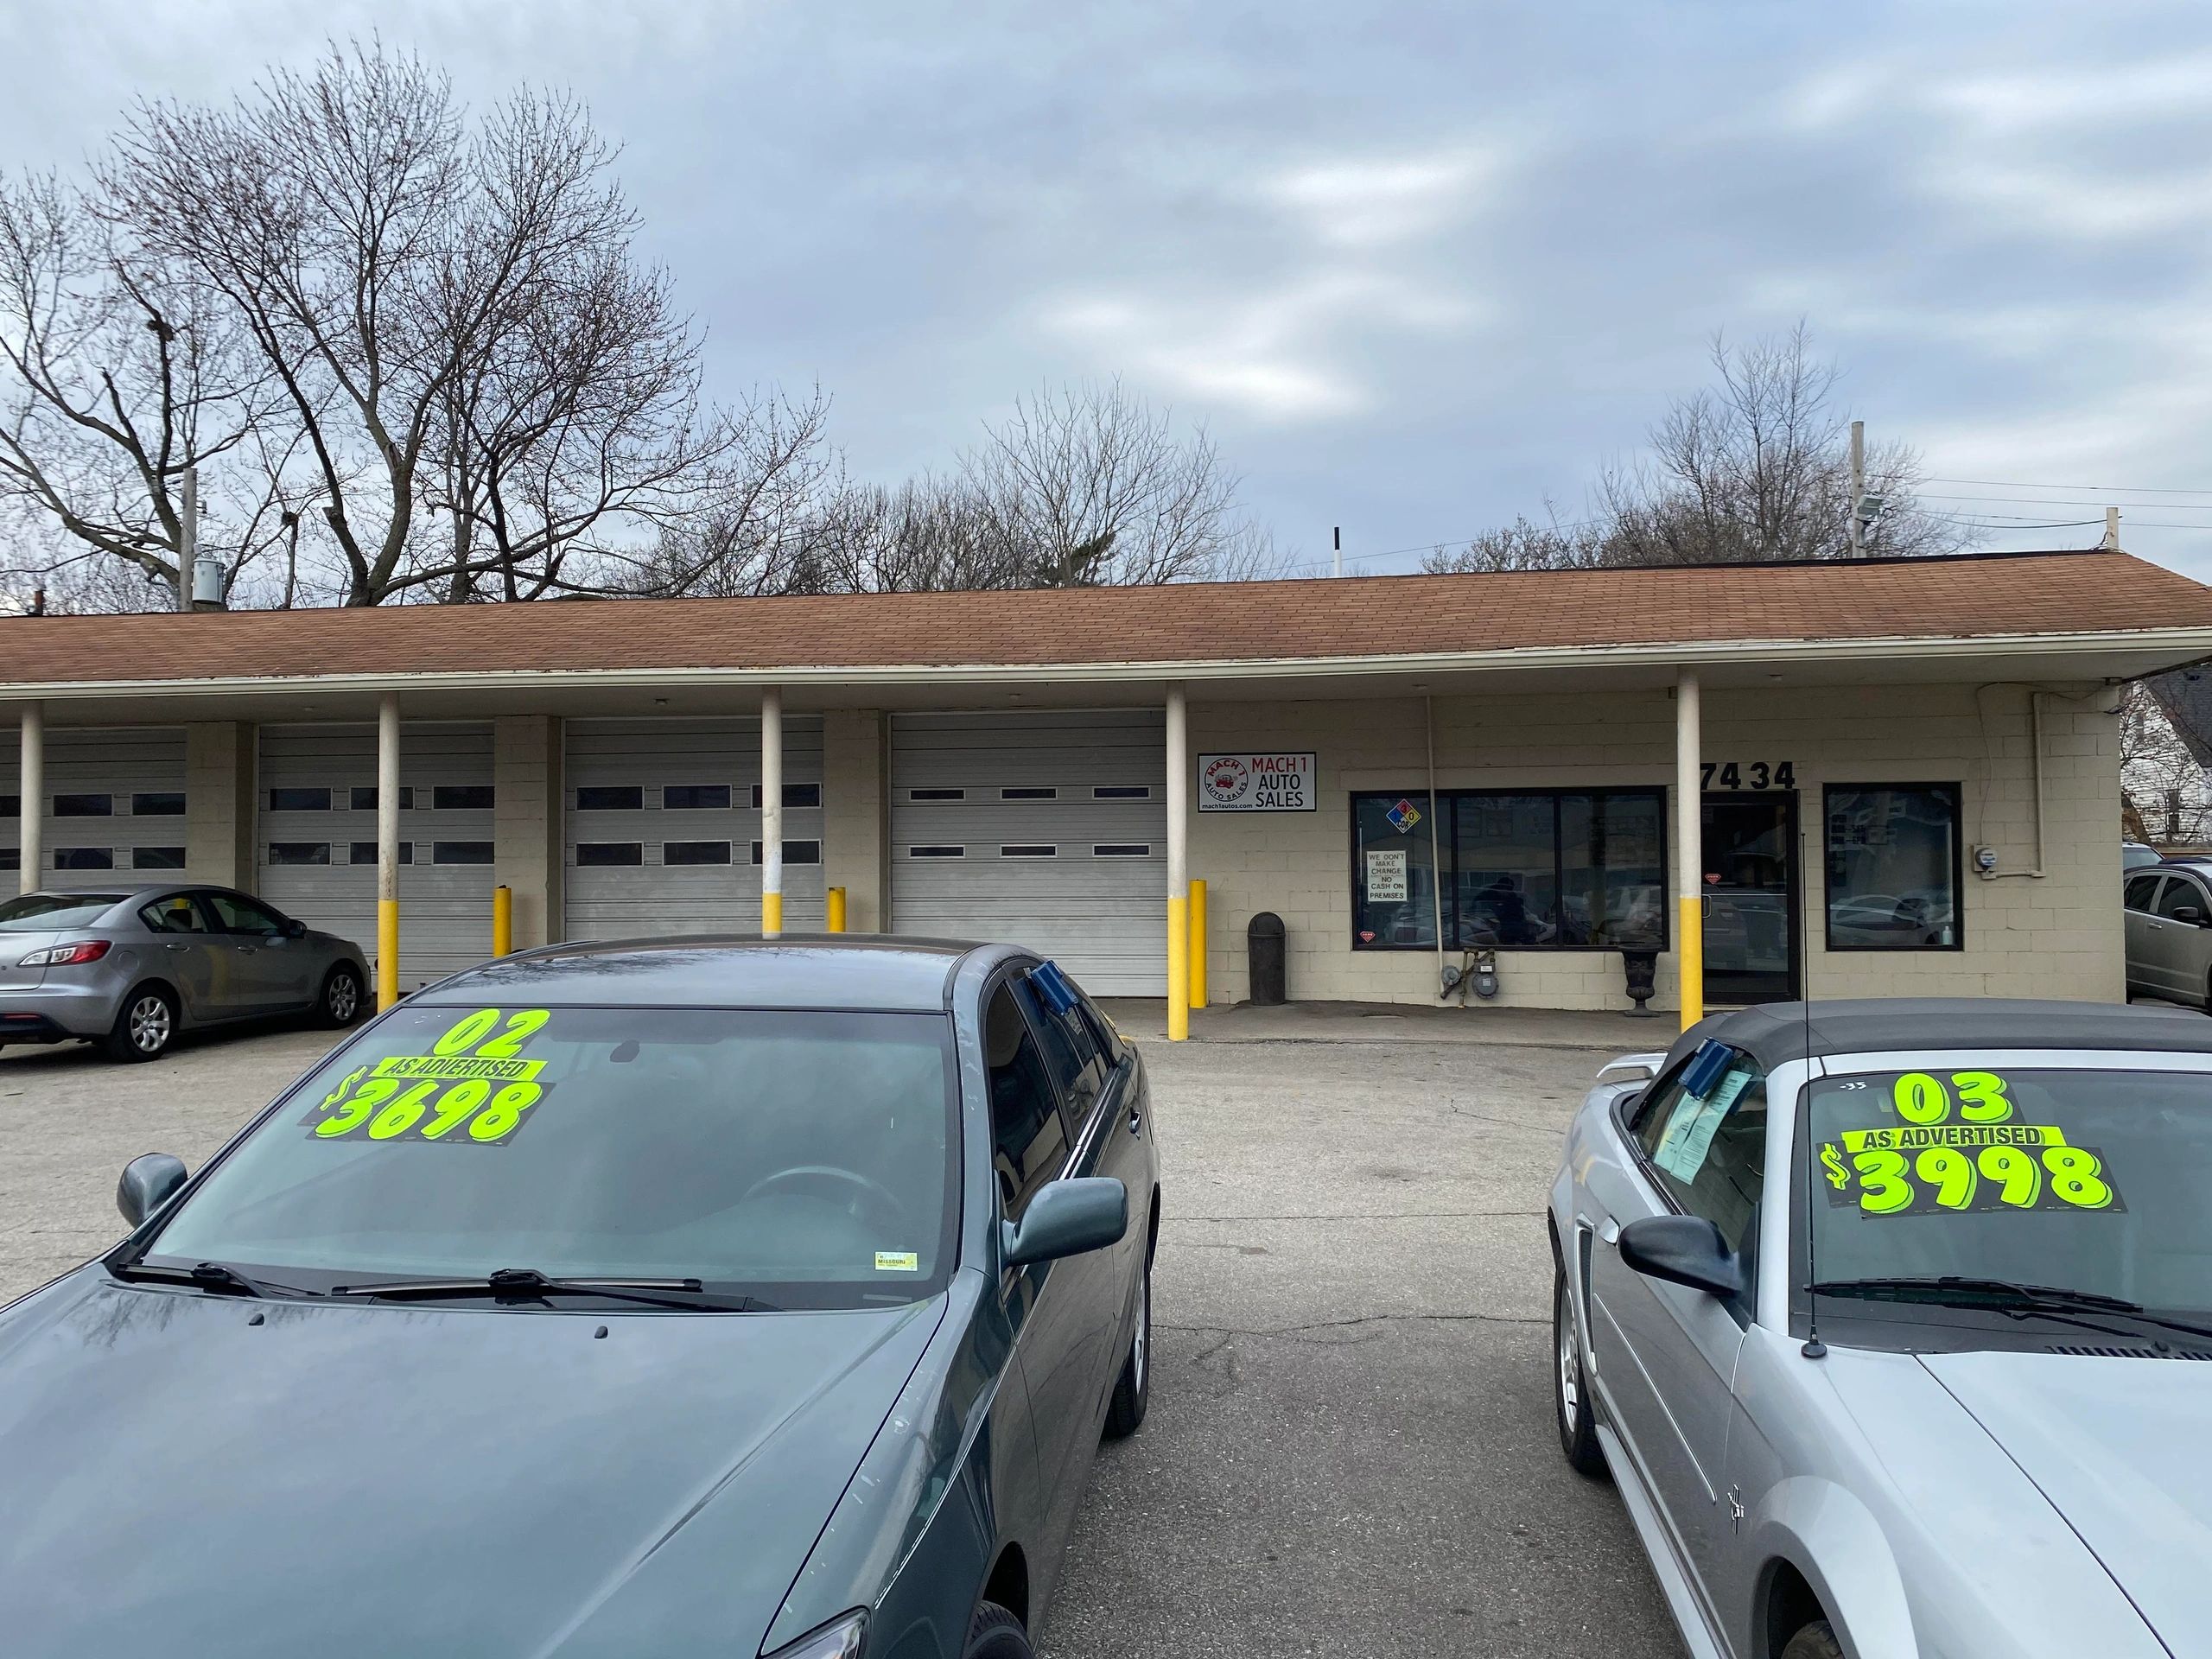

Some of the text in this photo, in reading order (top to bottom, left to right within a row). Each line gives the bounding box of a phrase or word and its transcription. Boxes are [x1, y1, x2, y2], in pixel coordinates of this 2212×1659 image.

[1208, 760, 1240, 777] MACH
[1252, 757, 1306, 772] MACH 1
[1258, 774, 1301, 790] AUTO
[1700, 761, 1796, 790] 7434
[1205, 781, 1248, 800] AUTO SALES
[1255, 791, 1304, 808] SALES
[1408, 812, 1414, 821] 0
[432, 1008, 551, 1058] 02
[384, 1058, 530, 1078] AS ADVERTISED
[315, 1065, 543, 1142] $3698
[1893, 1071, 2014, 1125] 03
[1862, 1128, 2044, 1149] AS ADVERTISED
[1819, 1143, 2113, 1214] $3998
